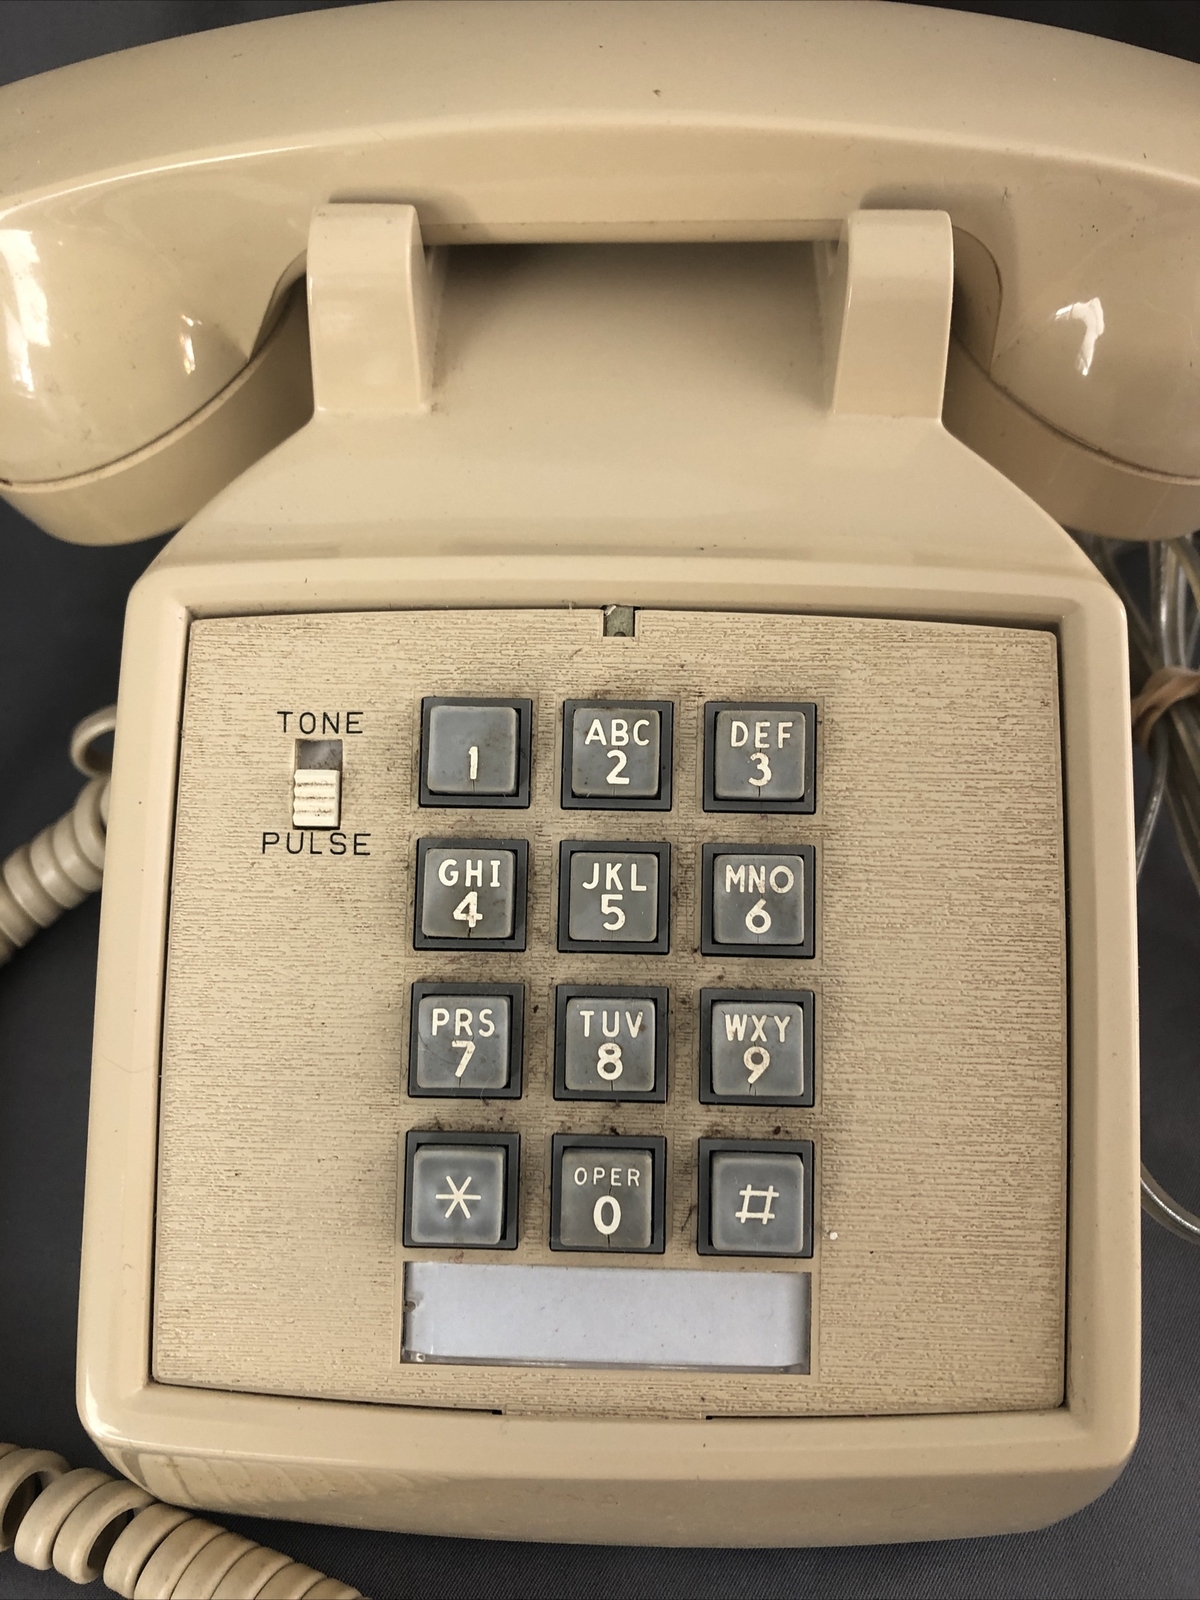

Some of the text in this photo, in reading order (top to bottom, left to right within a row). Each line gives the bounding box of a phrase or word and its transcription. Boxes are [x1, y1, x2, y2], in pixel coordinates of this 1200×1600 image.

[276, 710, 364, 735] TONE
[584, 718, 650, 746] ABC
[730, 720, 793, 749] DEF
[468, 746, 479, 780] 1
[606, 749, 630, 785] 2
[748, 752, 772, 787] 3
[261, 831, 372, 856] PULSE
[438, 858, 501, 888] GHI
[582, 862, 647, 892] JKL
[725, 864, 795, 894] MNO
[452, 891, 483, 928] 4
[601, 893, 626, 931] 5
[745, 898, 772, 934] 6
[431, 1008, 495, 1038] PRS
[579, 1010, 644, 1038] TUV
[724, 1013, 791, 1043] WXY
[451, 1040, 476, 1078] 7
[596, 1042, 623, 1081] 8
[743, 1046, 771, 1084] 9
[574, 1166, 640, 1187] OPER
[593, 1195, 622, 1235] 0
